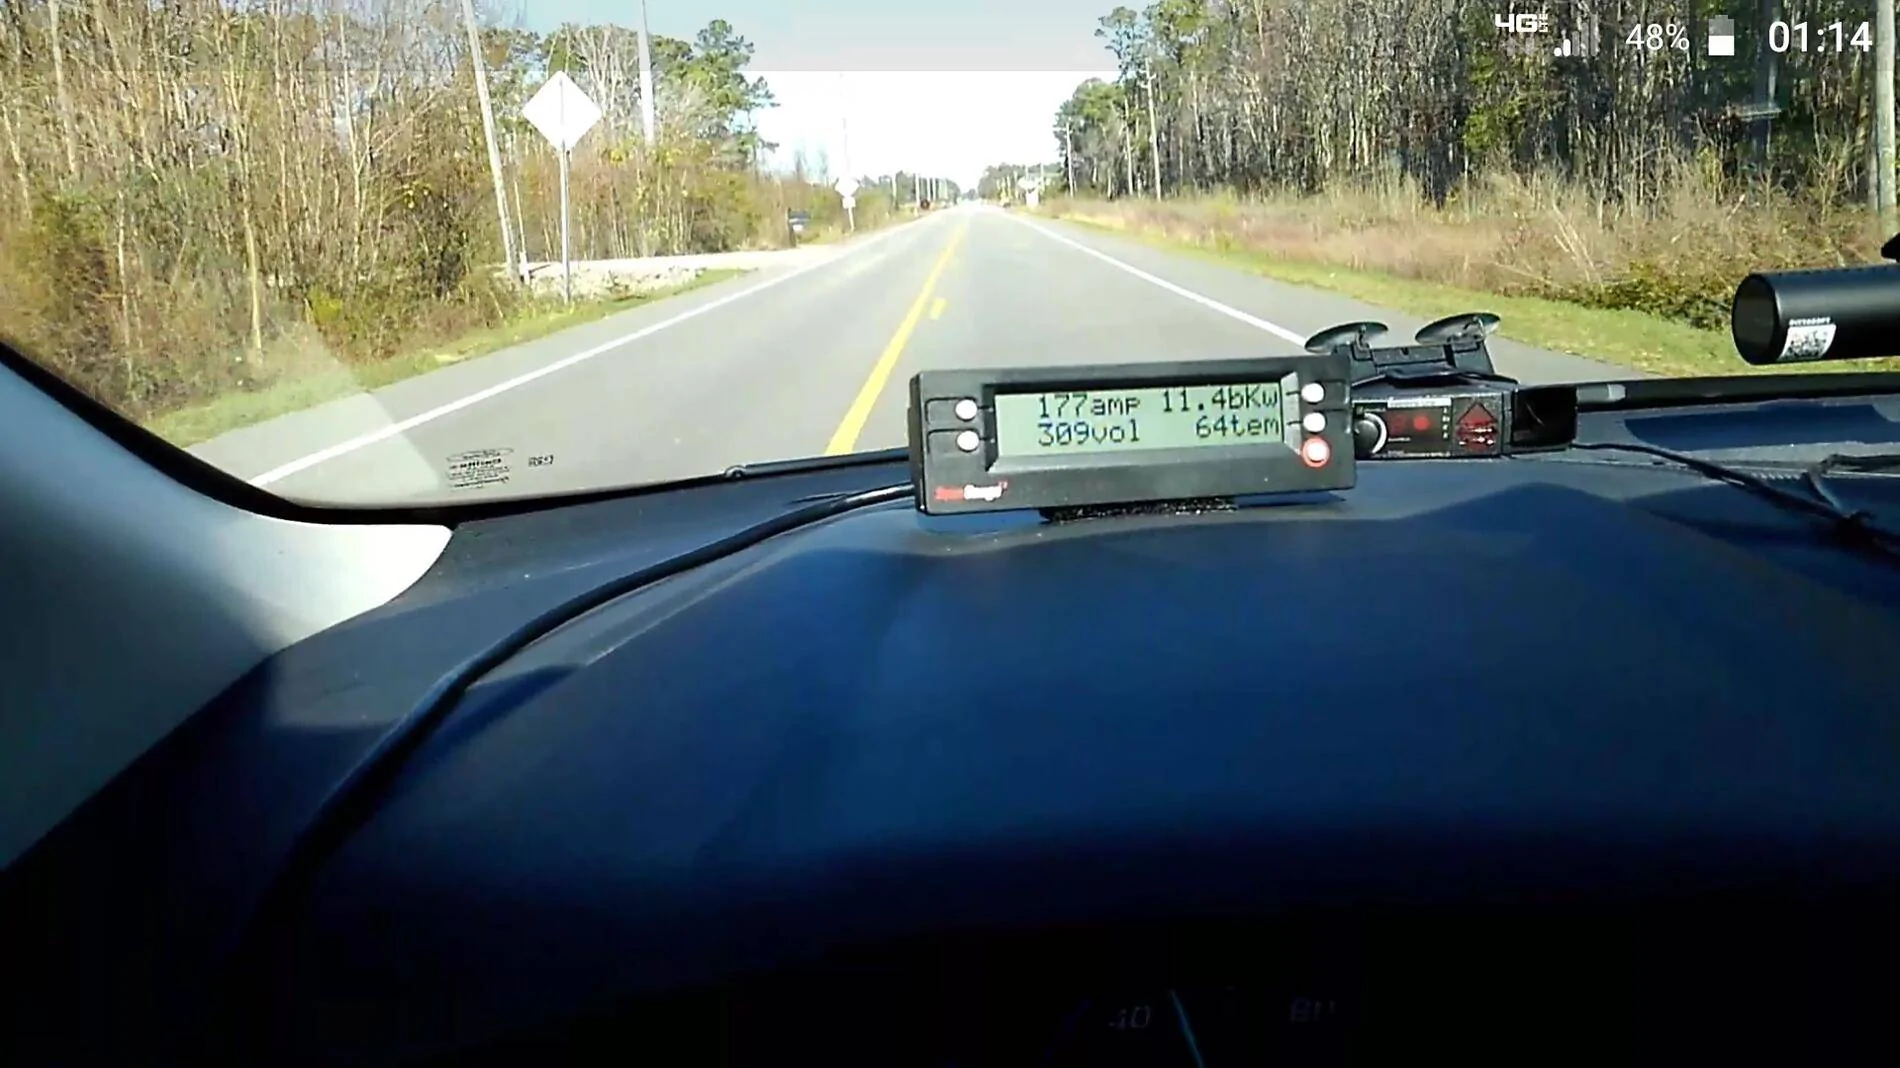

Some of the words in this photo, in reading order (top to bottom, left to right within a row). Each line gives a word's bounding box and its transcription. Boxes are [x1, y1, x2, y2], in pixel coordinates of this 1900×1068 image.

[1039, 391, 1141, 418] 177amp
[1038, 418, 1141, 447] 309vol
[1196, 415, 1280, 440] 64tem
